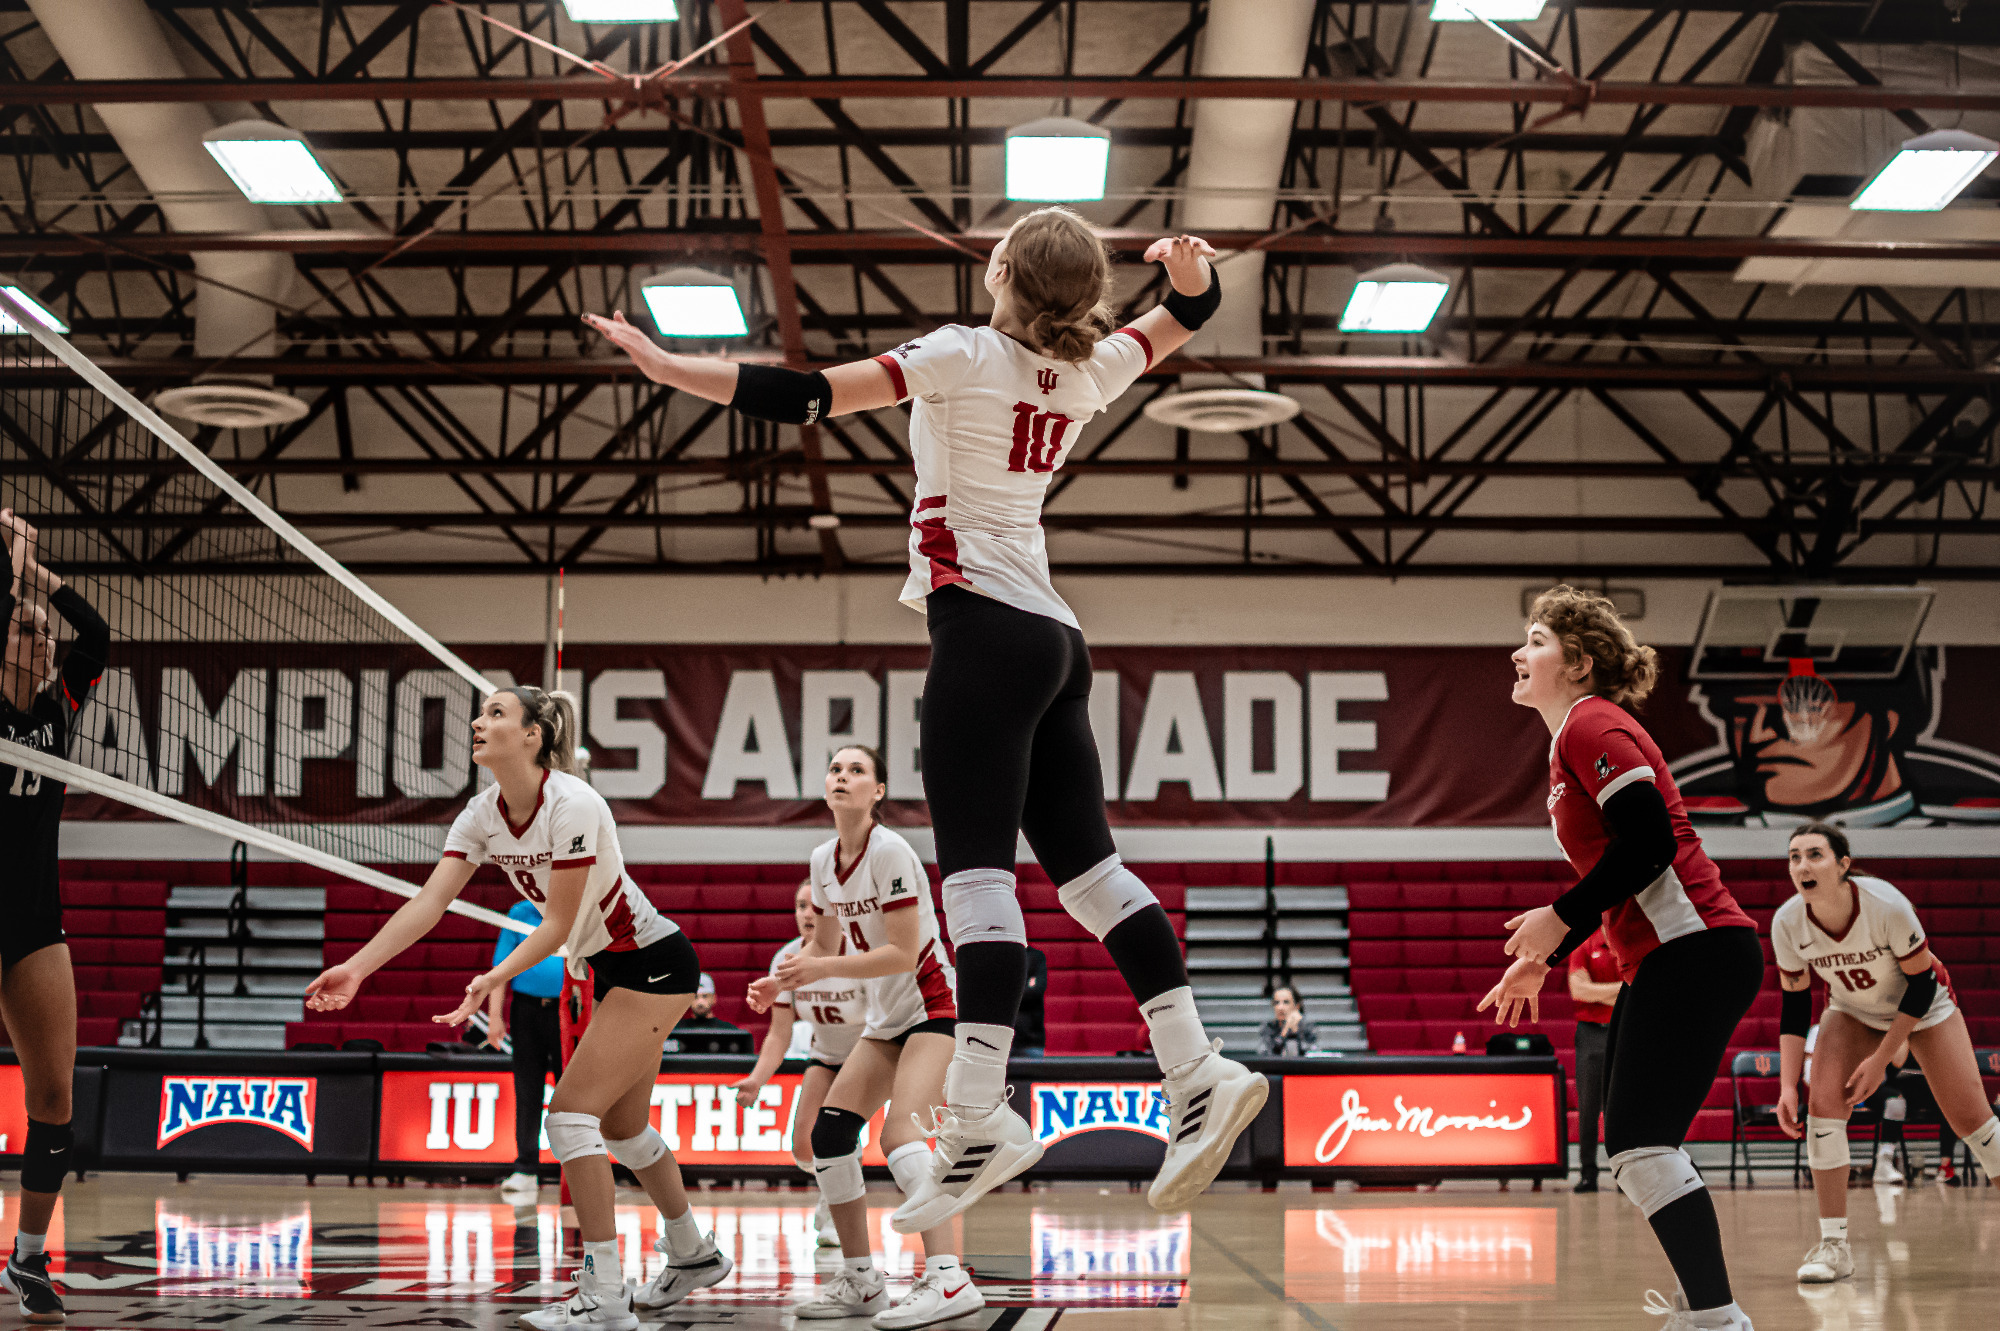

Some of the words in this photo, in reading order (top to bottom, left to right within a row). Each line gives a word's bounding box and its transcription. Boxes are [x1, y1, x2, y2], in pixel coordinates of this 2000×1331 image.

[1007, 401, 1074, 473] 10
[66, 667, 667, 799] AMPIOS
[514, 869, 547, 903] 8
[849, 921, 870, 952] 4
[1834, 968, 1877, 993] 18
[812, 1005, 846, 1025] 16
[159, 1078, 312, 1144] NAIA
[426, 1082, 500, 1150] IU
